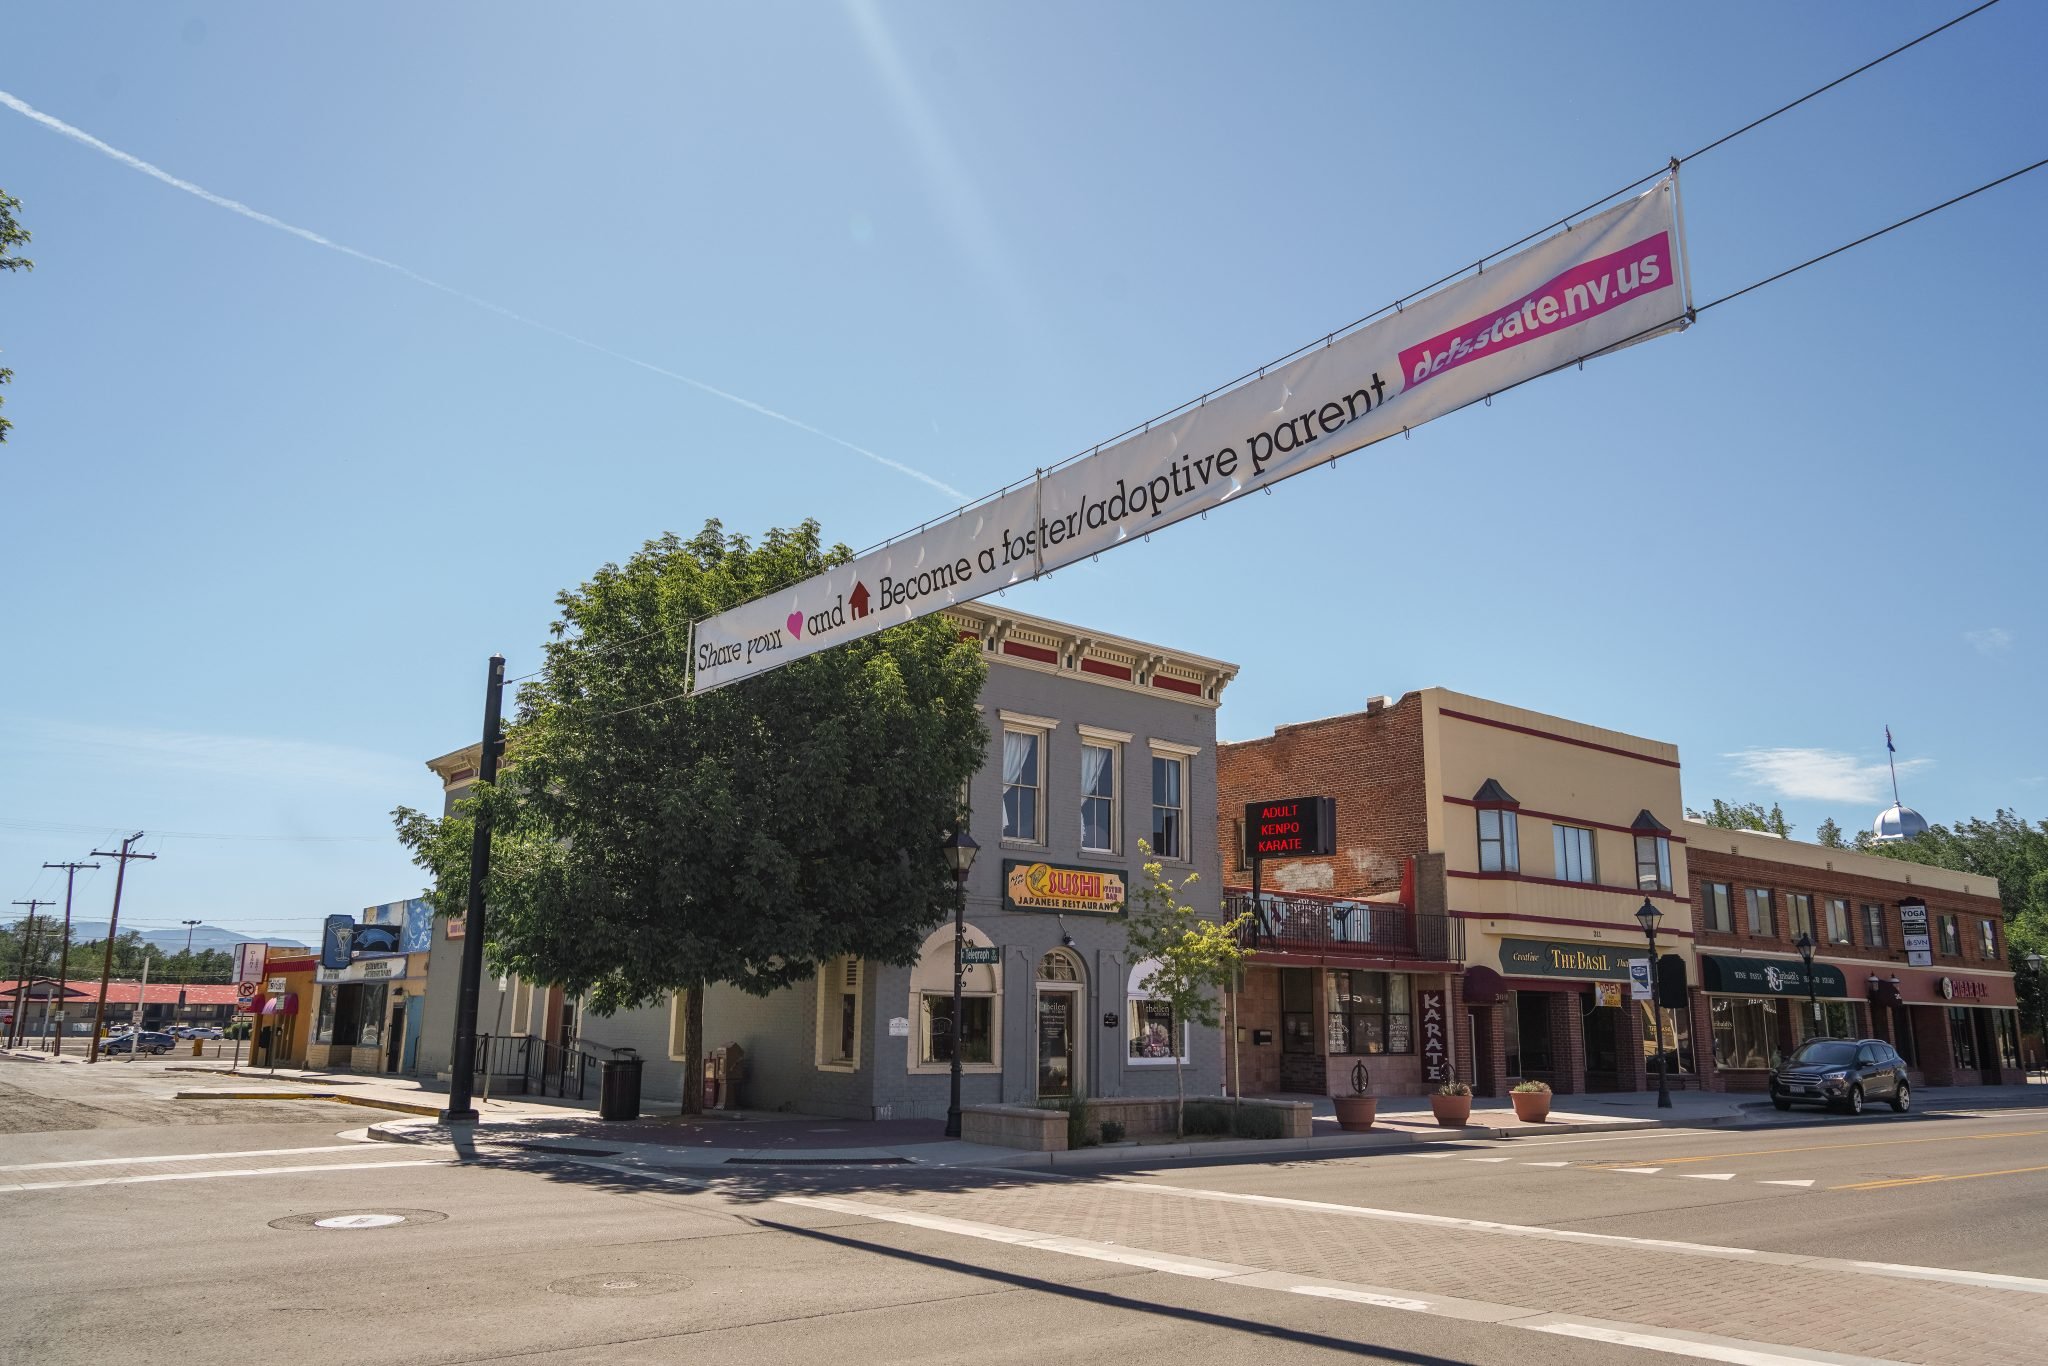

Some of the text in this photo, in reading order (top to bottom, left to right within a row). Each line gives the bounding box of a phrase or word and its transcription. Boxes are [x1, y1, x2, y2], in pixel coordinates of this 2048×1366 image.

[1413, 254, 1660, 382] dcfs.state.nv.us
[699, 373, 1386, 671] Share your and Become a foster/adoptive parent
[1262, 804, 1298, 818] ADULT
[1261, 822, 1300, 836] KENPO
[1258, 838, 1302, 852] KARATE
[1048, 872, 1101, 897] SUSHI
[1018, 897, 1115, 911] JAPANESE RESTAURANT
[966, 948, 990, 963] Telegraph
[1551, 949, 1577, 969] THE
[1576, 951, 1611, 971] BASIL
[1600, 983, 1621, 994] OPEN
[1423, 993, 1442, 1080] KARATE
